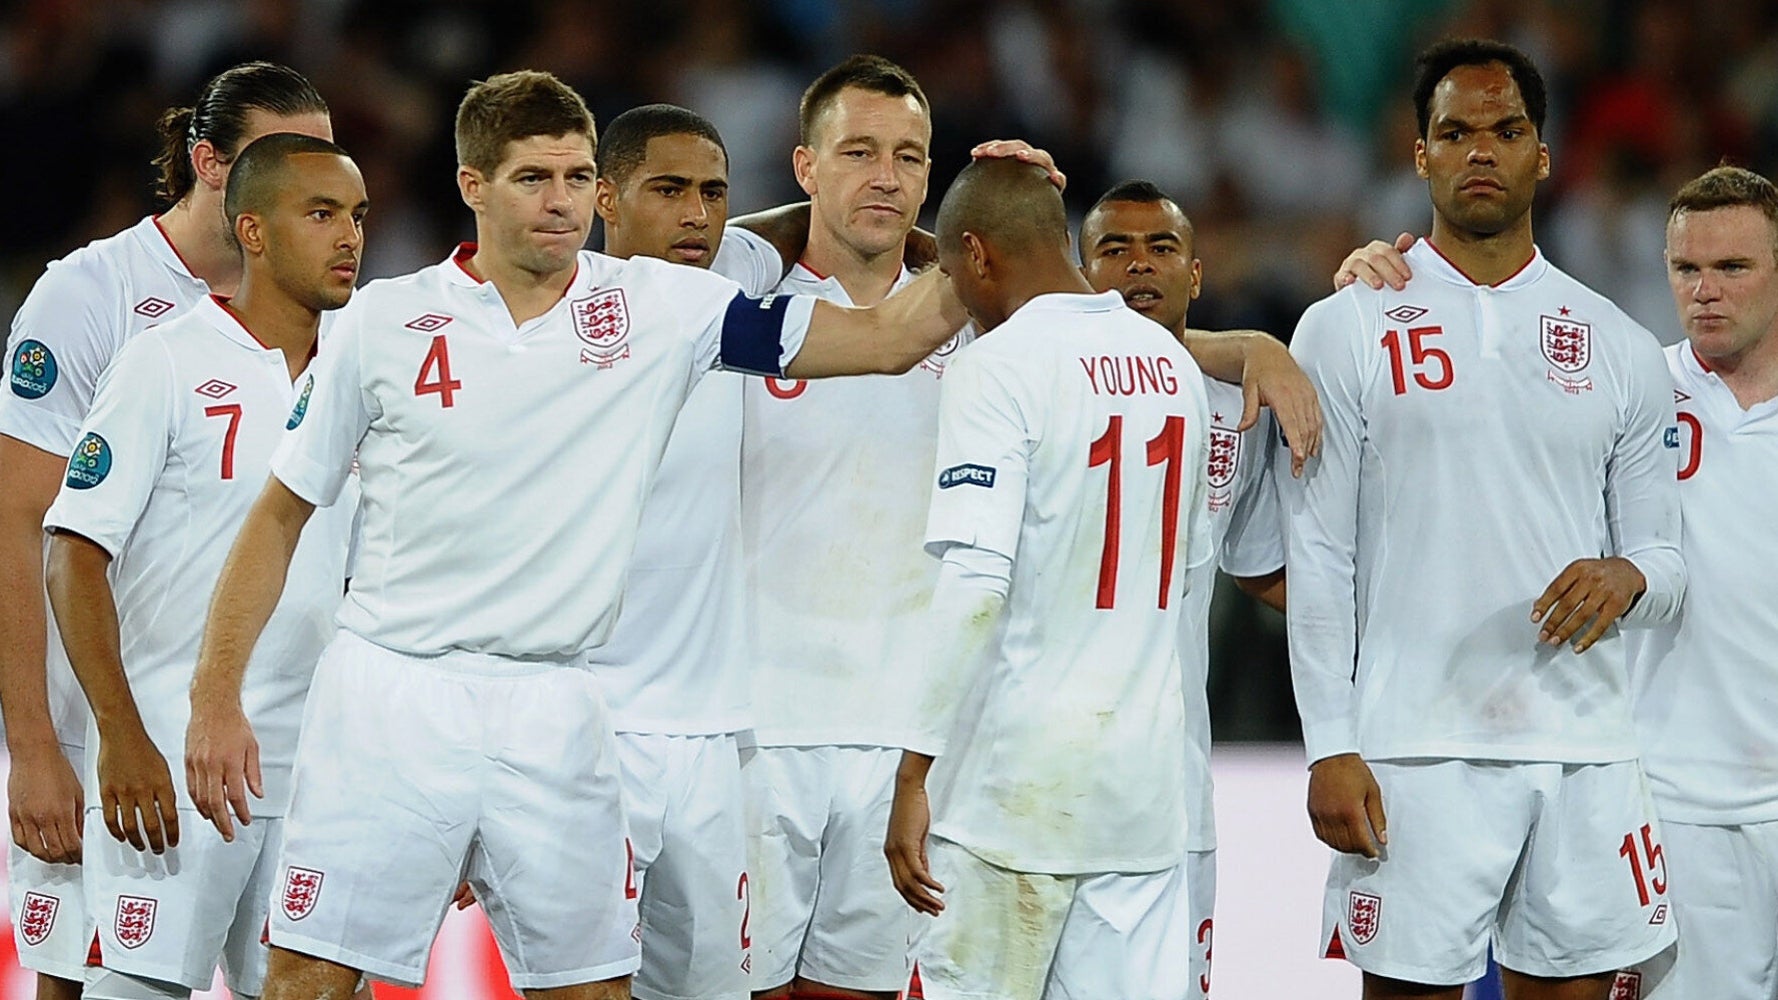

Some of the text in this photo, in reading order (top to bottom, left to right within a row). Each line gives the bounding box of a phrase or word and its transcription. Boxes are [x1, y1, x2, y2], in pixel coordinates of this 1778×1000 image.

[414, 335, 462, 408] 4
[1079, 355, 1178, 397] YOUNG
[1380, 326, 1455, 396] 15
[204, 403, 243, 479] 7
[951, 467, 993, 482] RESPECT
[1088, 415, 1185, 610] 11
[1618, 823, 1668, 908] 15
